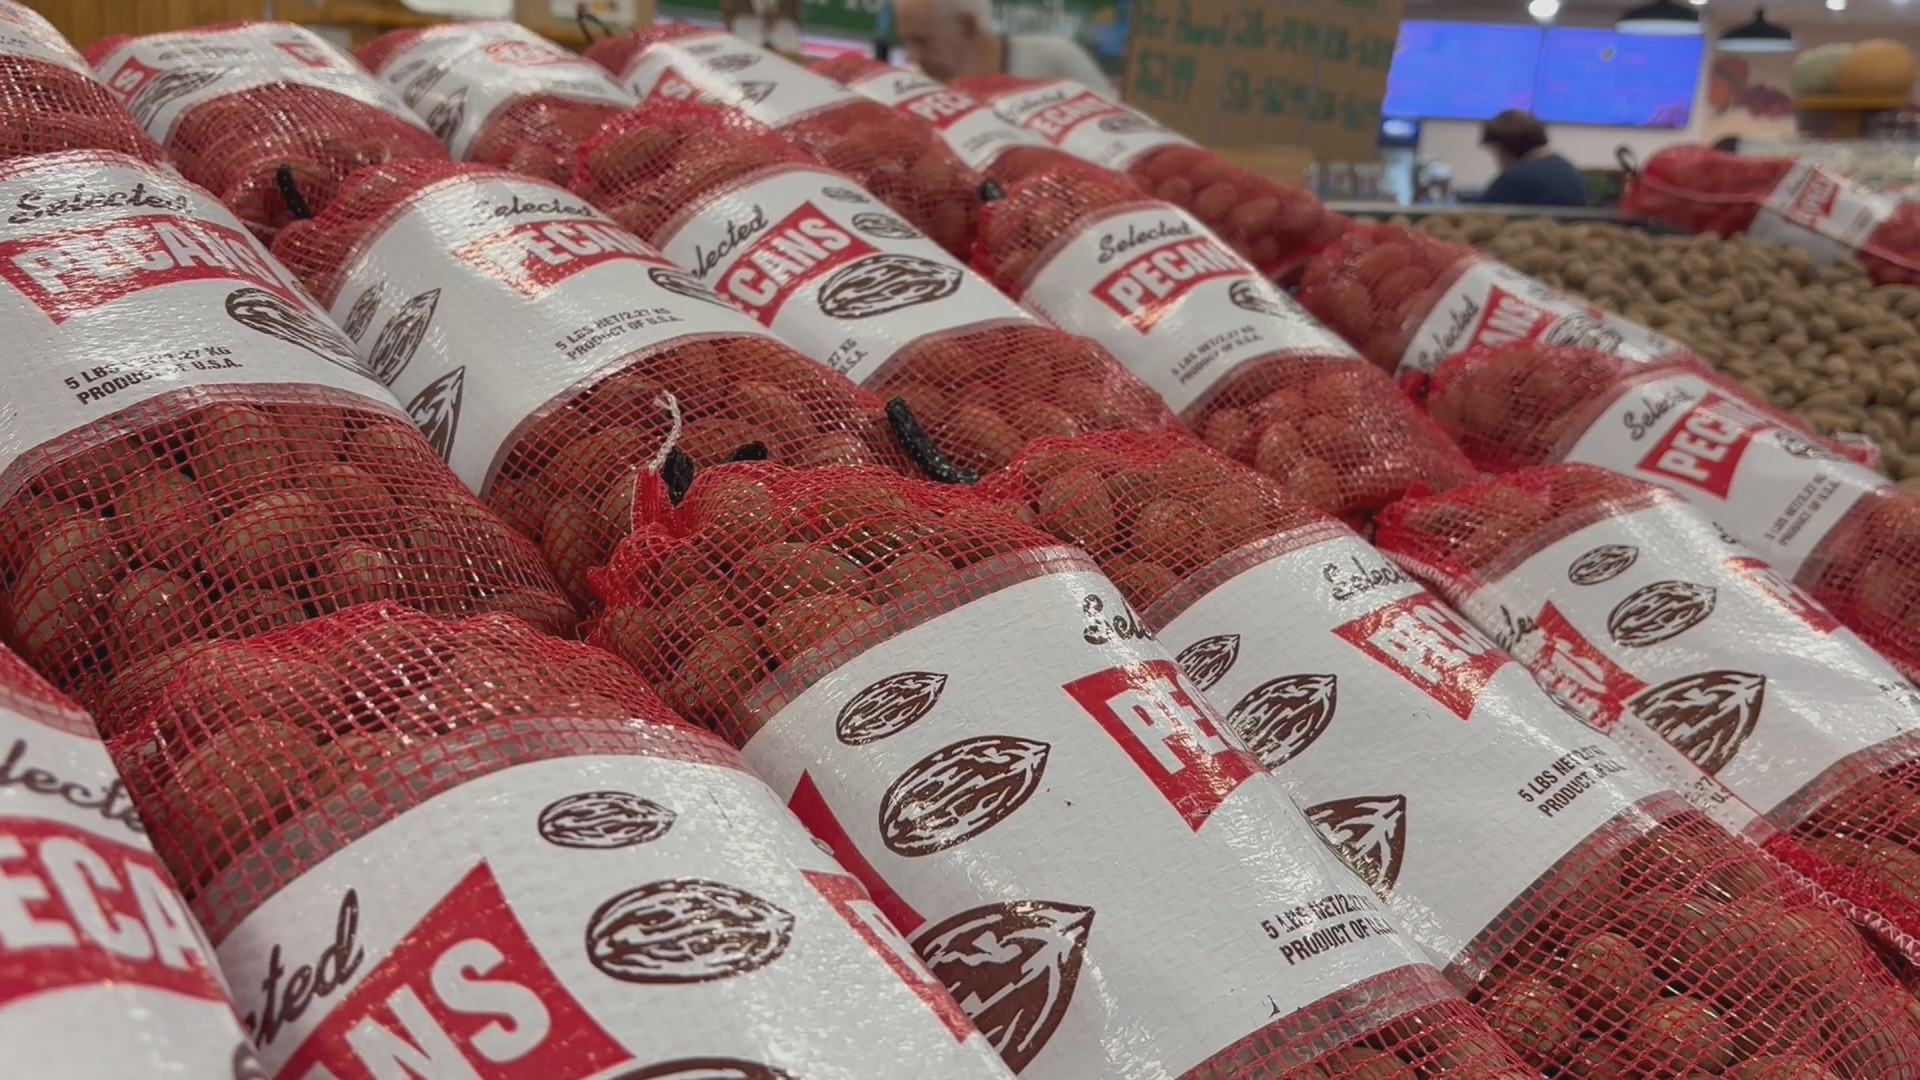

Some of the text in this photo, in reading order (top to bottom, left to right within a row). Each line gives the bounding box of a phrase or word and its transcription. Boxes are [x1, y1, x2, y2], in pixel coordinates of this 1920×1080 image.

[1097, 219, 1193, 264] Selected
[555, 340, 567, 350] 5
[193, 357, 244, 371] U.S.A.
[64, 377, 80, 390] 5
[1517, 786, 1534, 803] 5
[1527, 770, 1559, 796] LBS
[1537, 770, 1597, 818] PRODUCT
[1260, 920, 1280, 940] 5
[1278, 923, 1354, 967] PRODUCT
[1349, 917, 1370, 940] OF
